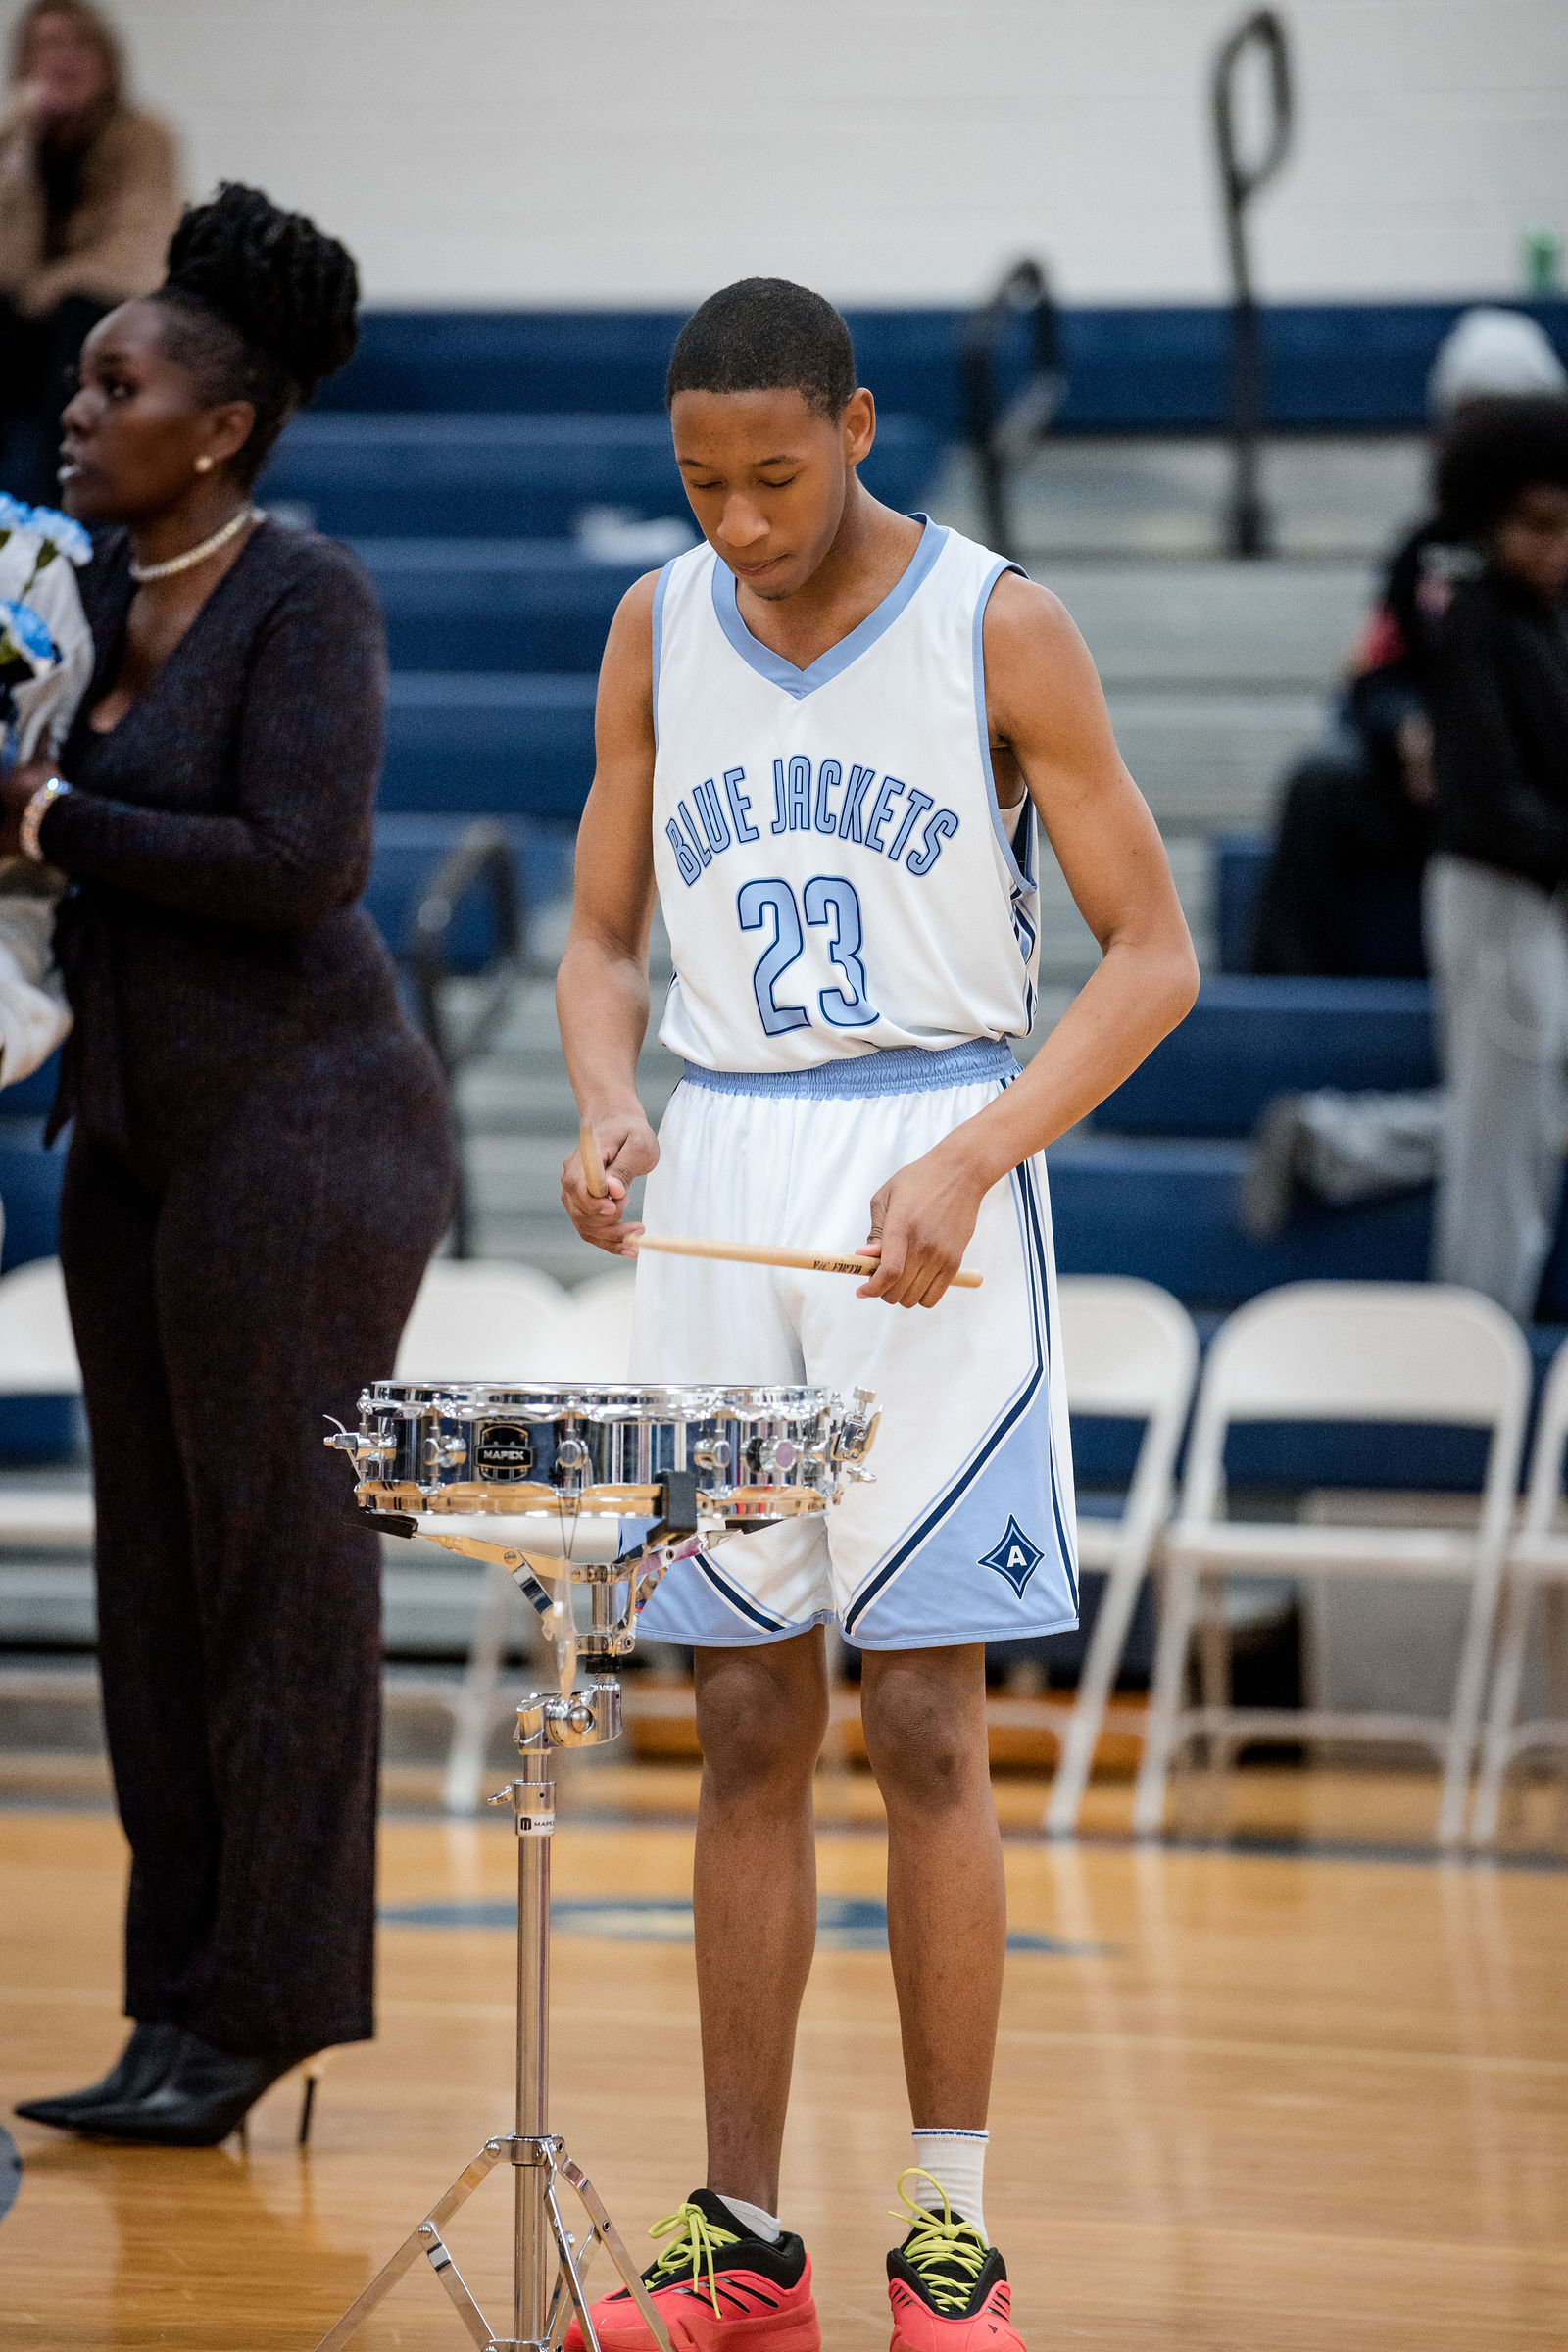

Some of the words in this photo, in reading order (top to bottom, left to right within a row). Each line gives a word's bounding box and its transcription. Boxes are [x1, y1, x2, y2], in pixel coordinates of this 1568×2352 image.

[666, 767, 759, 887] BLUE
[771, 755, 959, 876] JACKETS
[737, 876, 881, 1037] 23
[483, 1450, 524, 1460] MAPEX
[1006, 1545, 1028, 1568] A
